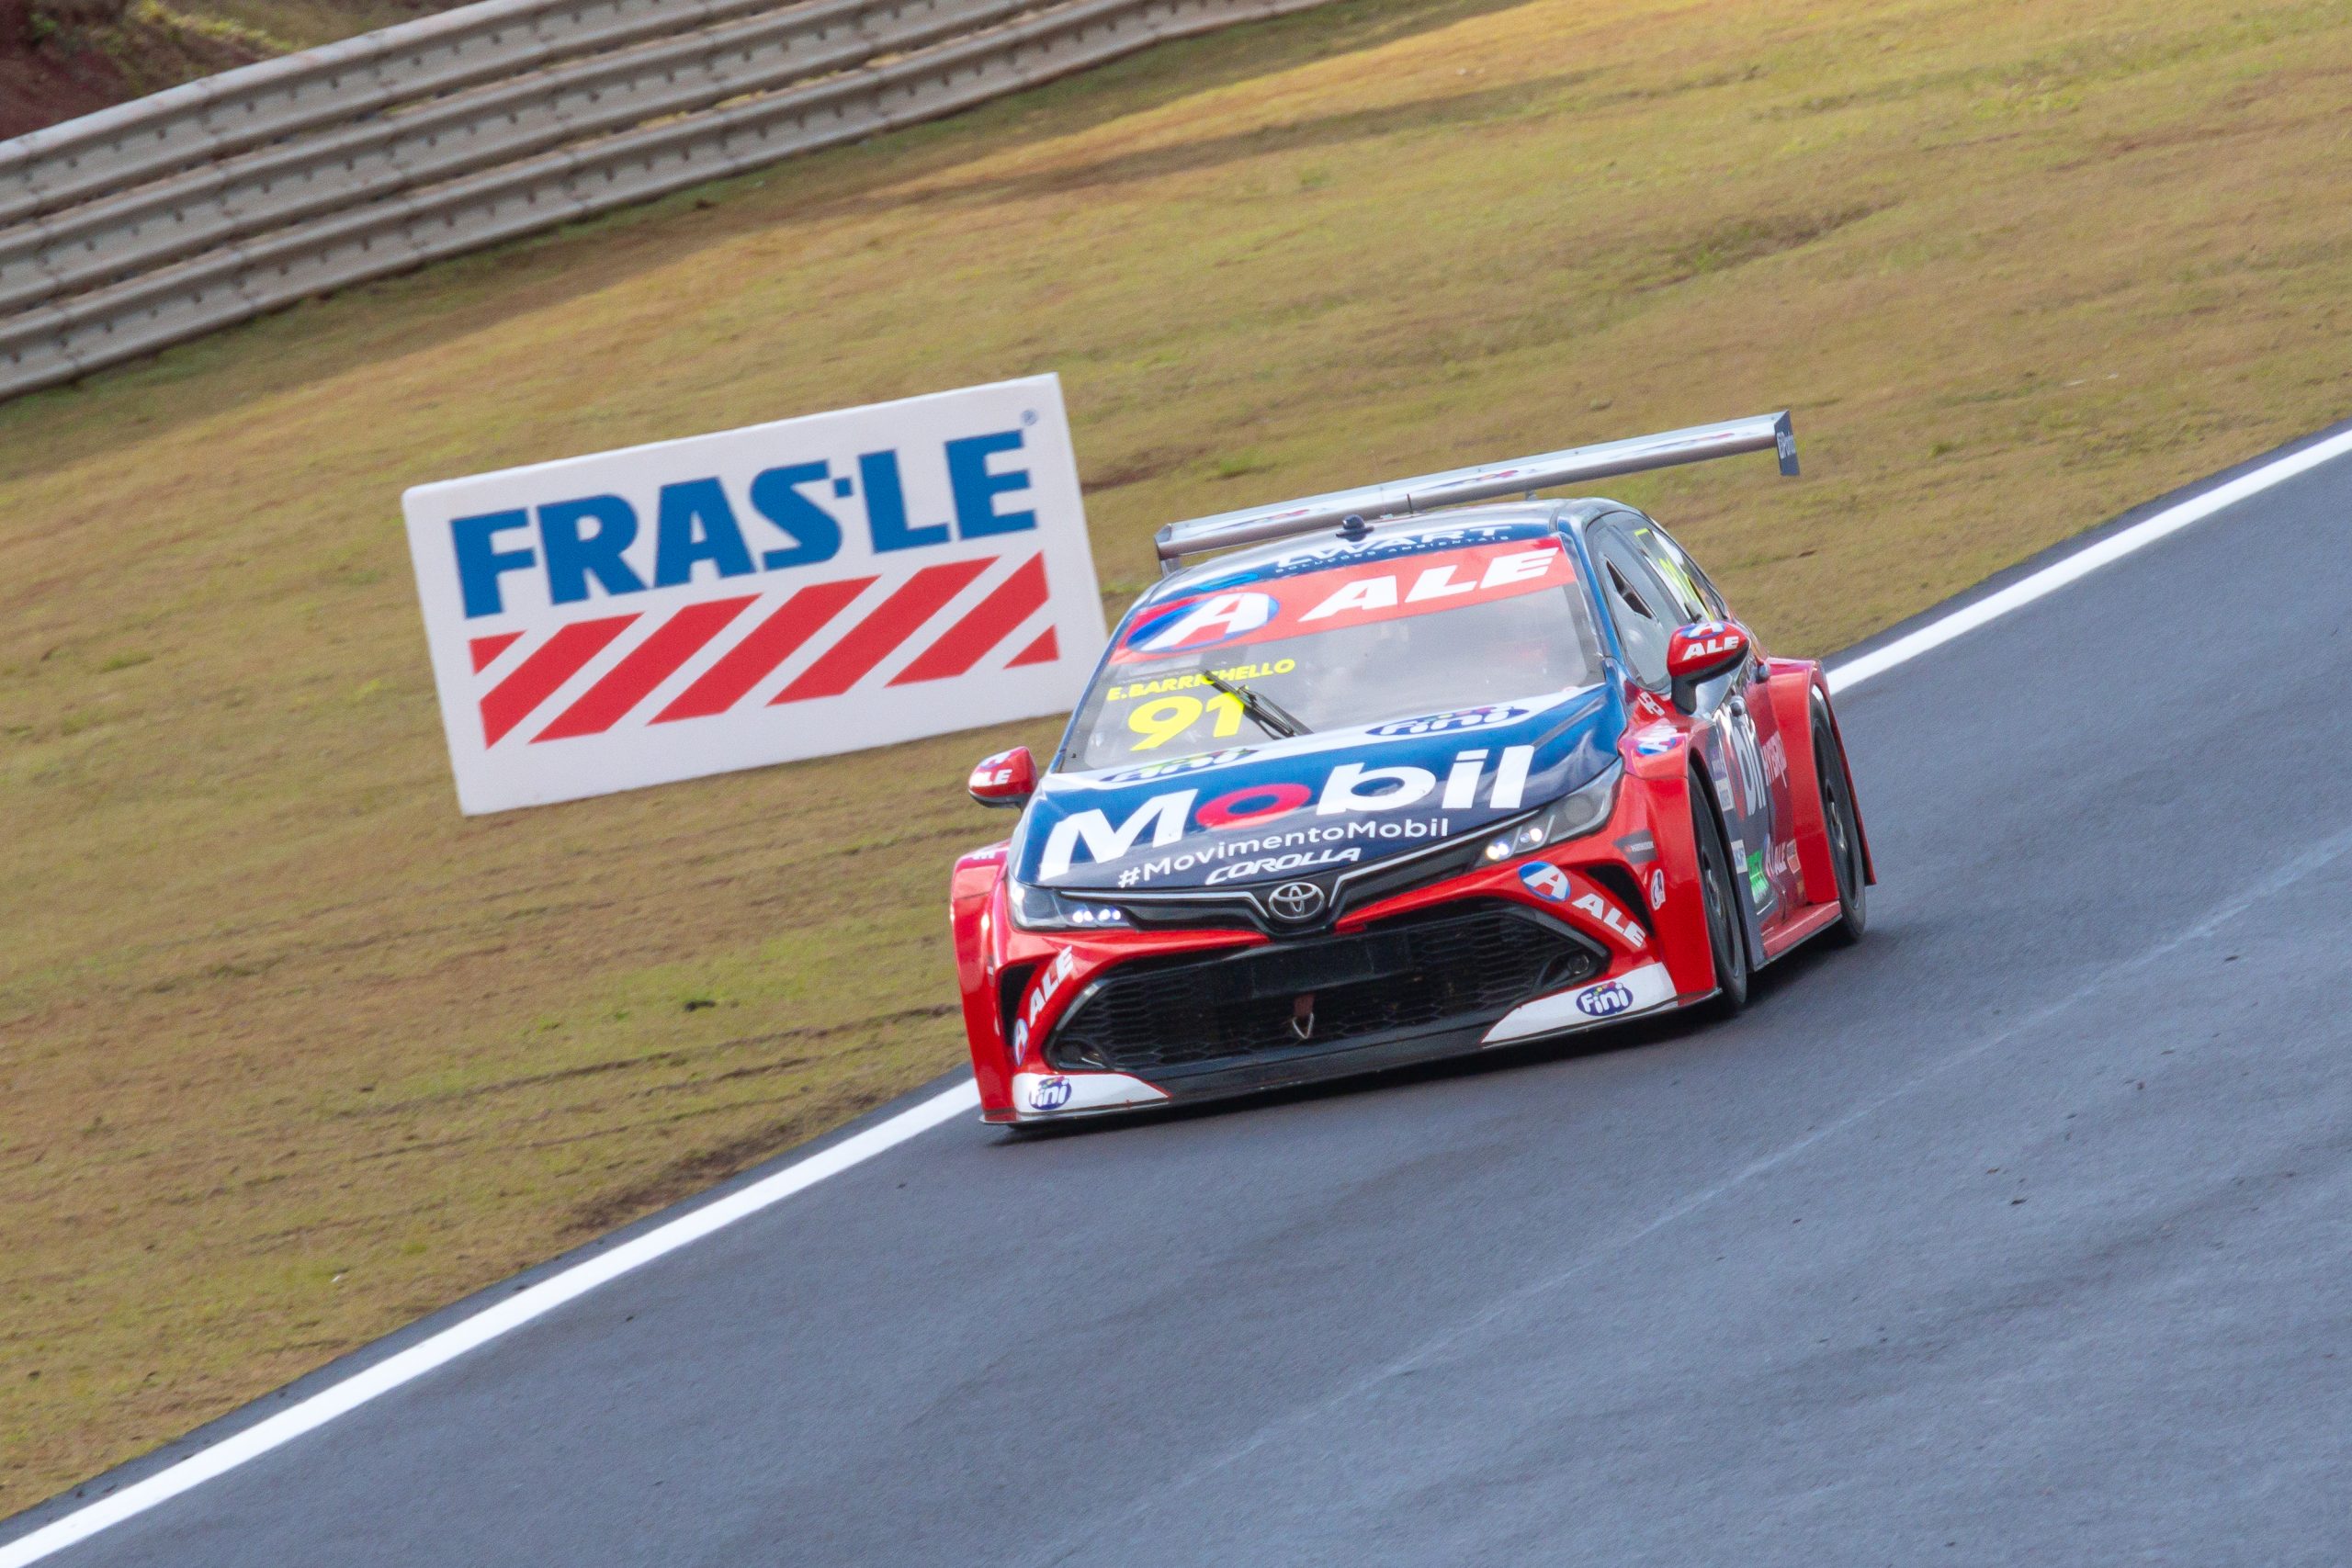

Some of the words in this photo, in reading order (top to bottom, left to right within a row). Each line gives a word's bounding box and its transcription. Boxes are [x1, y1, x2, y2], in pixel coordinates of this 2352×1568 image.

[1297, 547, 1559, 622] ALE
[1682, 636, 1739, 661] ALE
[1128, 695, 1245, 751] 91
[1039, 745, 1535, 882] Mobil
[1118, 818, 1449, 888] #MovimentoMobil
[1205, 848, 1361, 886] COROLLA
[1572, 893, 1646, 948] ALE
[1029, 944, 1073, 1029] ALE
[1580, 981, 1630, 1014] Fini
